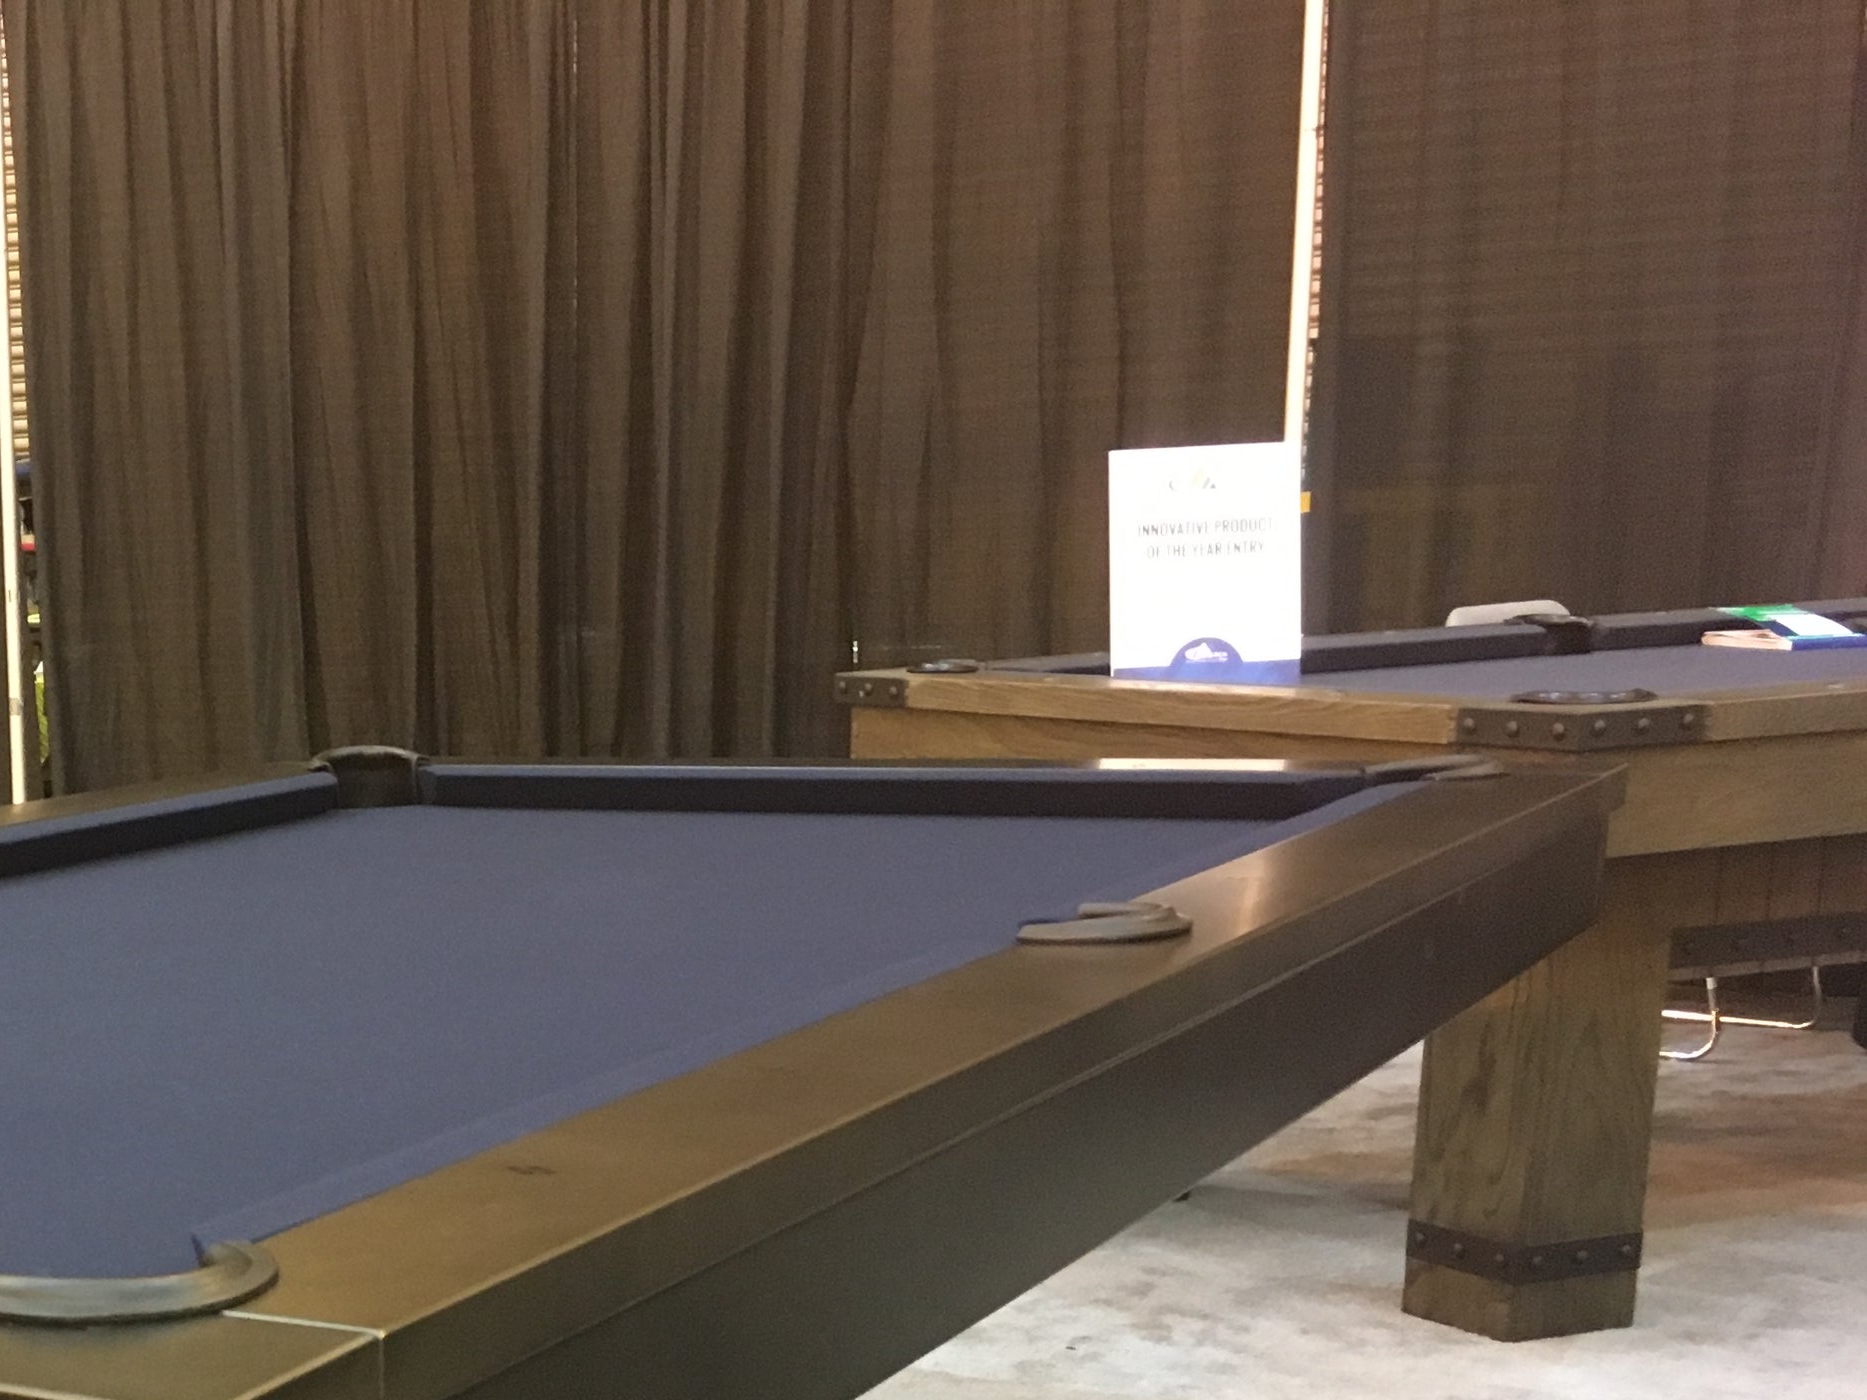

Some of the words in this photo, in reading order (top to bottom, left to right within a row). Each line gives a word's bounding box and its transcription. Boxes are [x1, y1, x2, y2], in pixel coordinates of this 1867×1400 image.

[1137, 520, 1209, 537] INNOVATIVE
[1214, 517, 1274, 533] PRODUCT
[1146, 544, 1160, 560] OF
[1166, 543, 1187, 558] THE
[1193, 542, 1223, 557] YEAR
[1227, 540, 1265, 556] ENTRY
